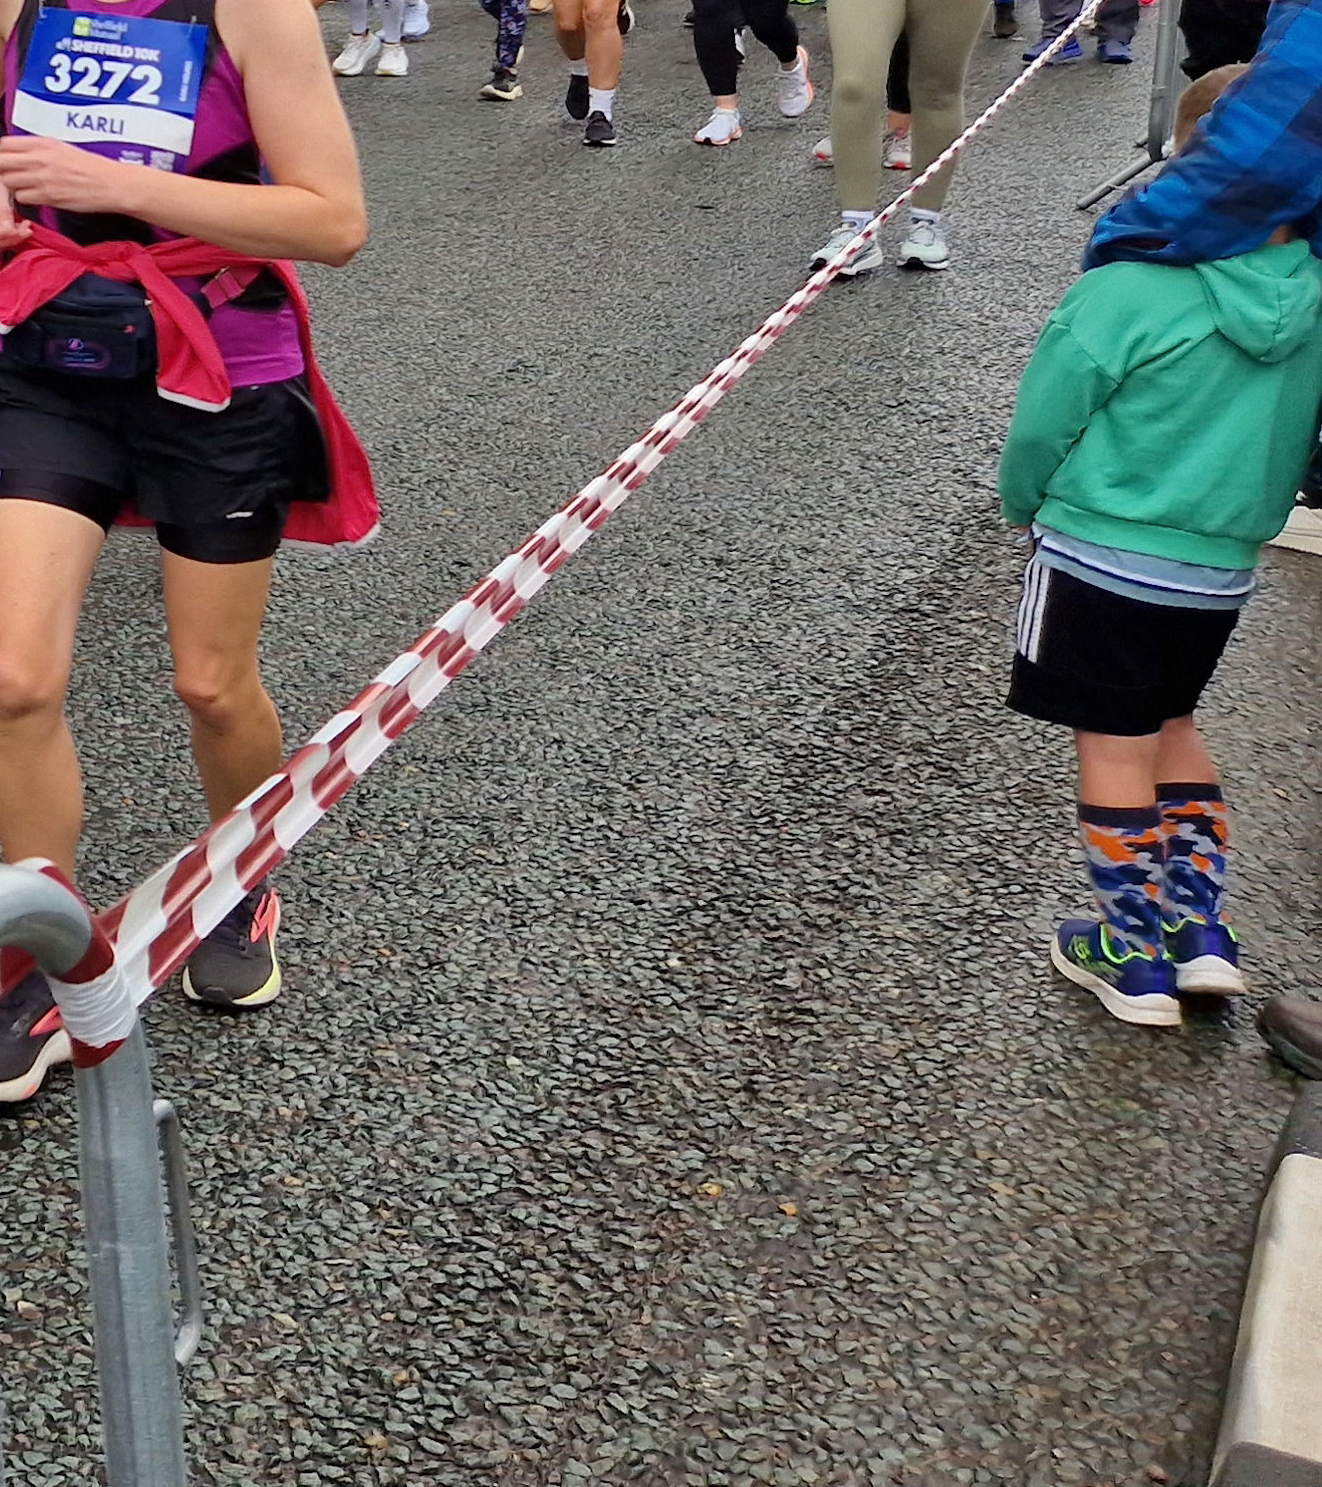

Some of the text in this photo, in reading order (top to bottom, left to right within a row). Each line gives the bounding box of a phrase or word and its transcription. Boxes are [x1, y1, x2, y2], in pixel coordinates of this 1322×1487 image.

[71, 41, 162, 62] SHEFFIELD 10K
[45, 53, 163, 105] 3272
[66, 111, 124, 135] KARLI
